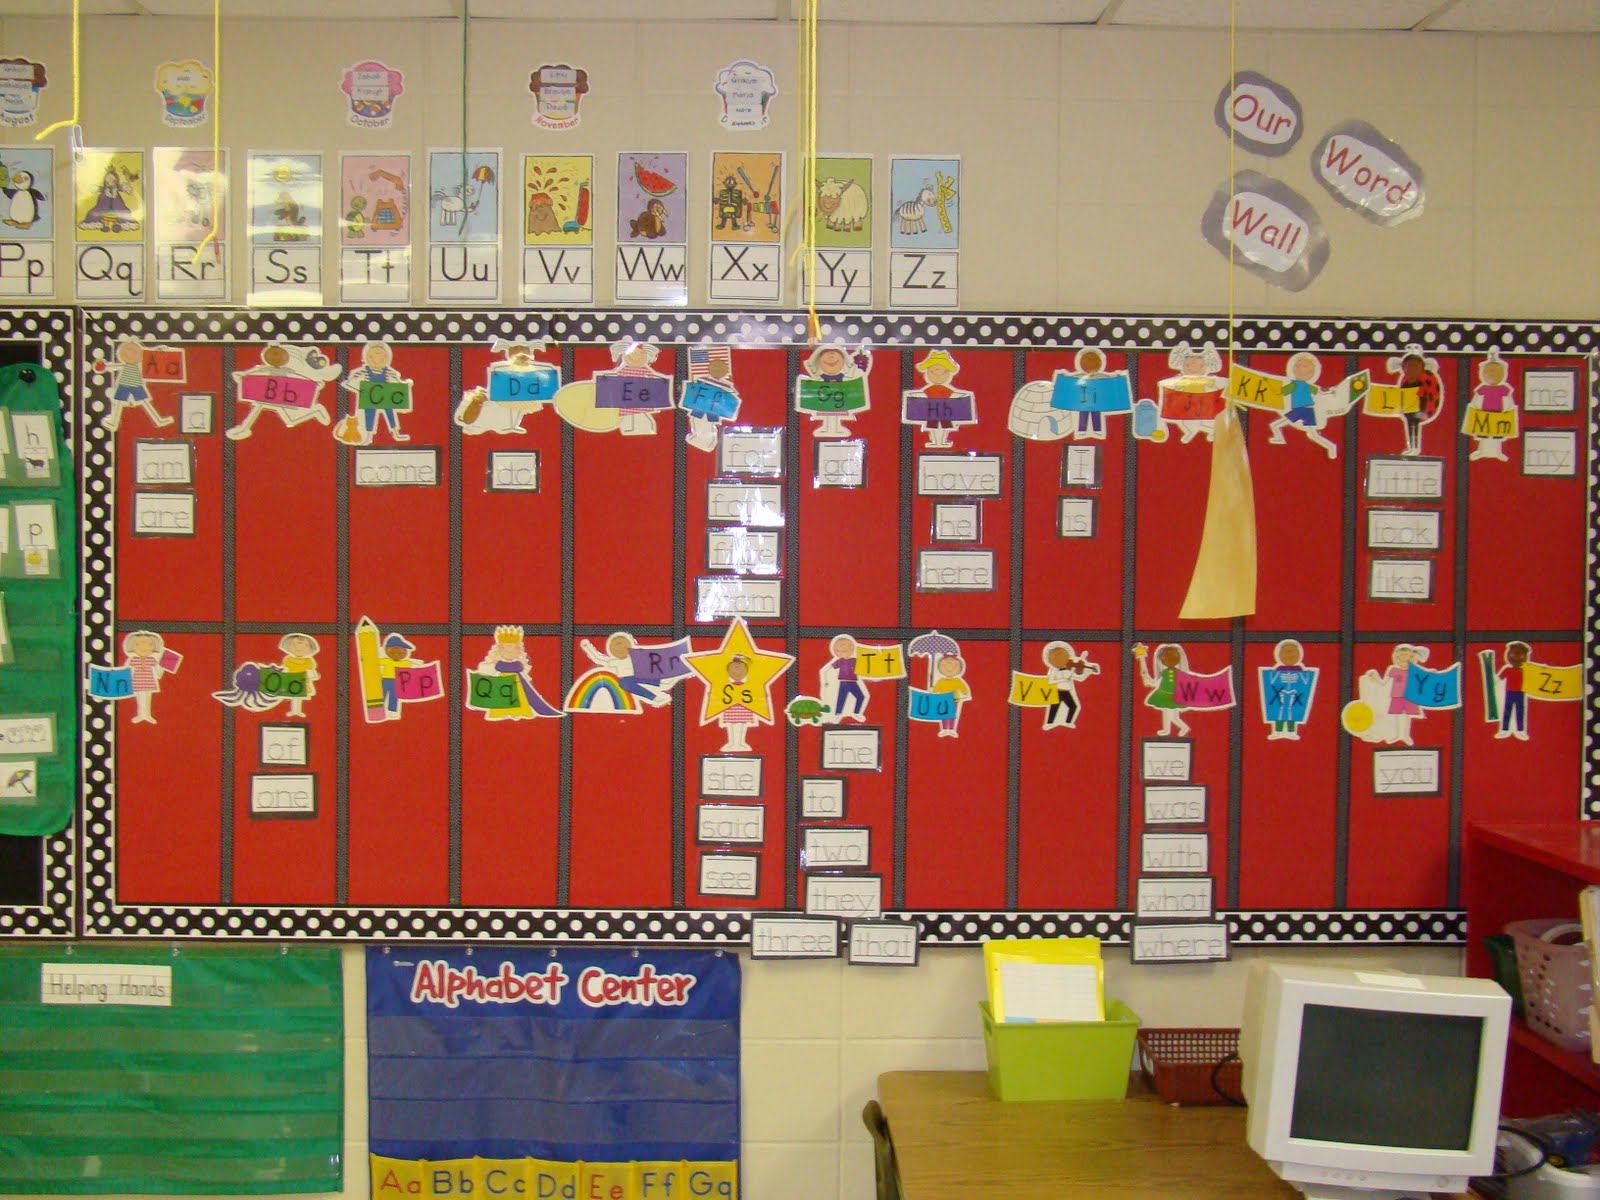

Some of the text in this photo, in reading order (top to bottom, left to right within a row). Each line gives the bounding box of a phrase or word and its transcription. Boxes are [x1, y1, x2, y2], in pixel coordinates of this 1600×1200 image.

[351, 114, 390, 128] October
[535, 115, 579, 129] November
[1231, 94, 1291, 135] Our
[1325, 138, 1413, 206] Word
[1231, 199, 1301, 254] Wall
[0, 243, 44, 294] Pp
[79, 247, 142, 296] Qq
[171, 246, 215, 280] Rr
[266, 249, 308, 283] Ss
[354, 250, 396, 284] Tt
[441, 247, 489, 283] Uu
[539, 250, 581, 284] Vv
[619, 248, 685, 282] Ww
[721, 247, 769, 282] Xx
[902, 254, 947, 289] Zz
[818, 253, 858, 304] Yy
[1529, 388, 1568, 406] me
[189, 411, 206, 429] a
[143, 461, 184, 480] am
[360, 464, 434, 483] come
[497, 462, 533, 485] do
[1527, 449, 1570, 473] my
[923, 466, 996, 491] have
[1376, 470, 1437, 494] little
[711, 494, 777, 517] fo
[140, 510, 190, 528] are
[940, 512, 972, 536] he
[1065, 511, 1087, 531] is
[29, 522, 43, 546] p
[1374, 522, 1431, 544] look
[713, 541, 774, 566] fe
[924, 559, 989, 584] here
[1376, 568, 1425, 593] like
[702, 588, 775, 613] om
[268, 737, 300, 761] of
[830, 741, 873, 764] the
[707, 769, 754, 791] she
[1148, 758, 1185, 777] we
[1379, 766, 1434, 792] you
[257, 789, 309, 809] one
[807, 790, 837, 813] to
[1148, 801, 1202, 820] was
[702, 816, 760, 839] said
[811, 839, 862, 861] two
[1146, 841, 1203, 868] with
[706, 870, 752, 889] see
[812, 883, 876, 917] they
[1142, 887, 1208, 911] what
[756, 927, 833, 952] three
[855, 931, 912, 956] that
[1138, 932, 1223, 957] where
[51, 973, 166, 1002] Helping Hands
[412, 961, 695, 1006] Alphabet Center
